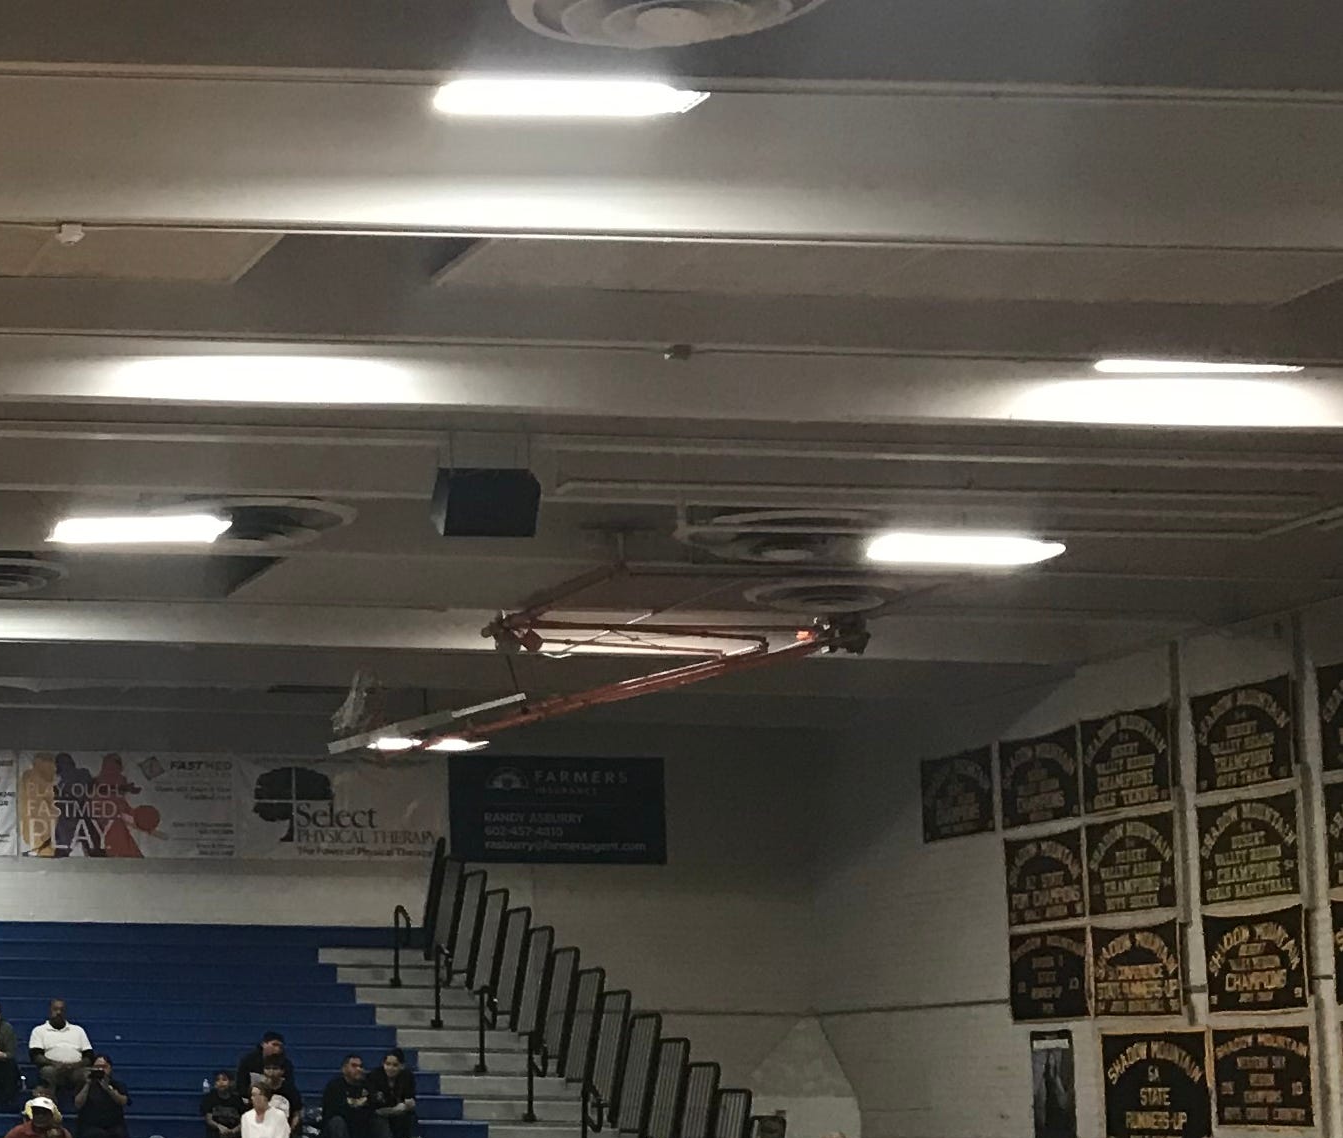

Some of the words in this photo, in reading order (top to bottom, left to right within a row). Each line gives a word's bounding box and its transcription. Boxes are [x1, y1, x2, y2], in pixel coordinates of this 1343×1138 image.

[534, 769, 628, 785] FARMERS
[26, 800, 118, 819] FASTMED.
[296, 802, 378, 829] Select
[483, 812, 523, 824] RANDY
[296, 830, 366, 845] PHYSICAL
[372, 830, 436, 845] THERAPY
[1140, 1087, 1171, 1106] STATE
